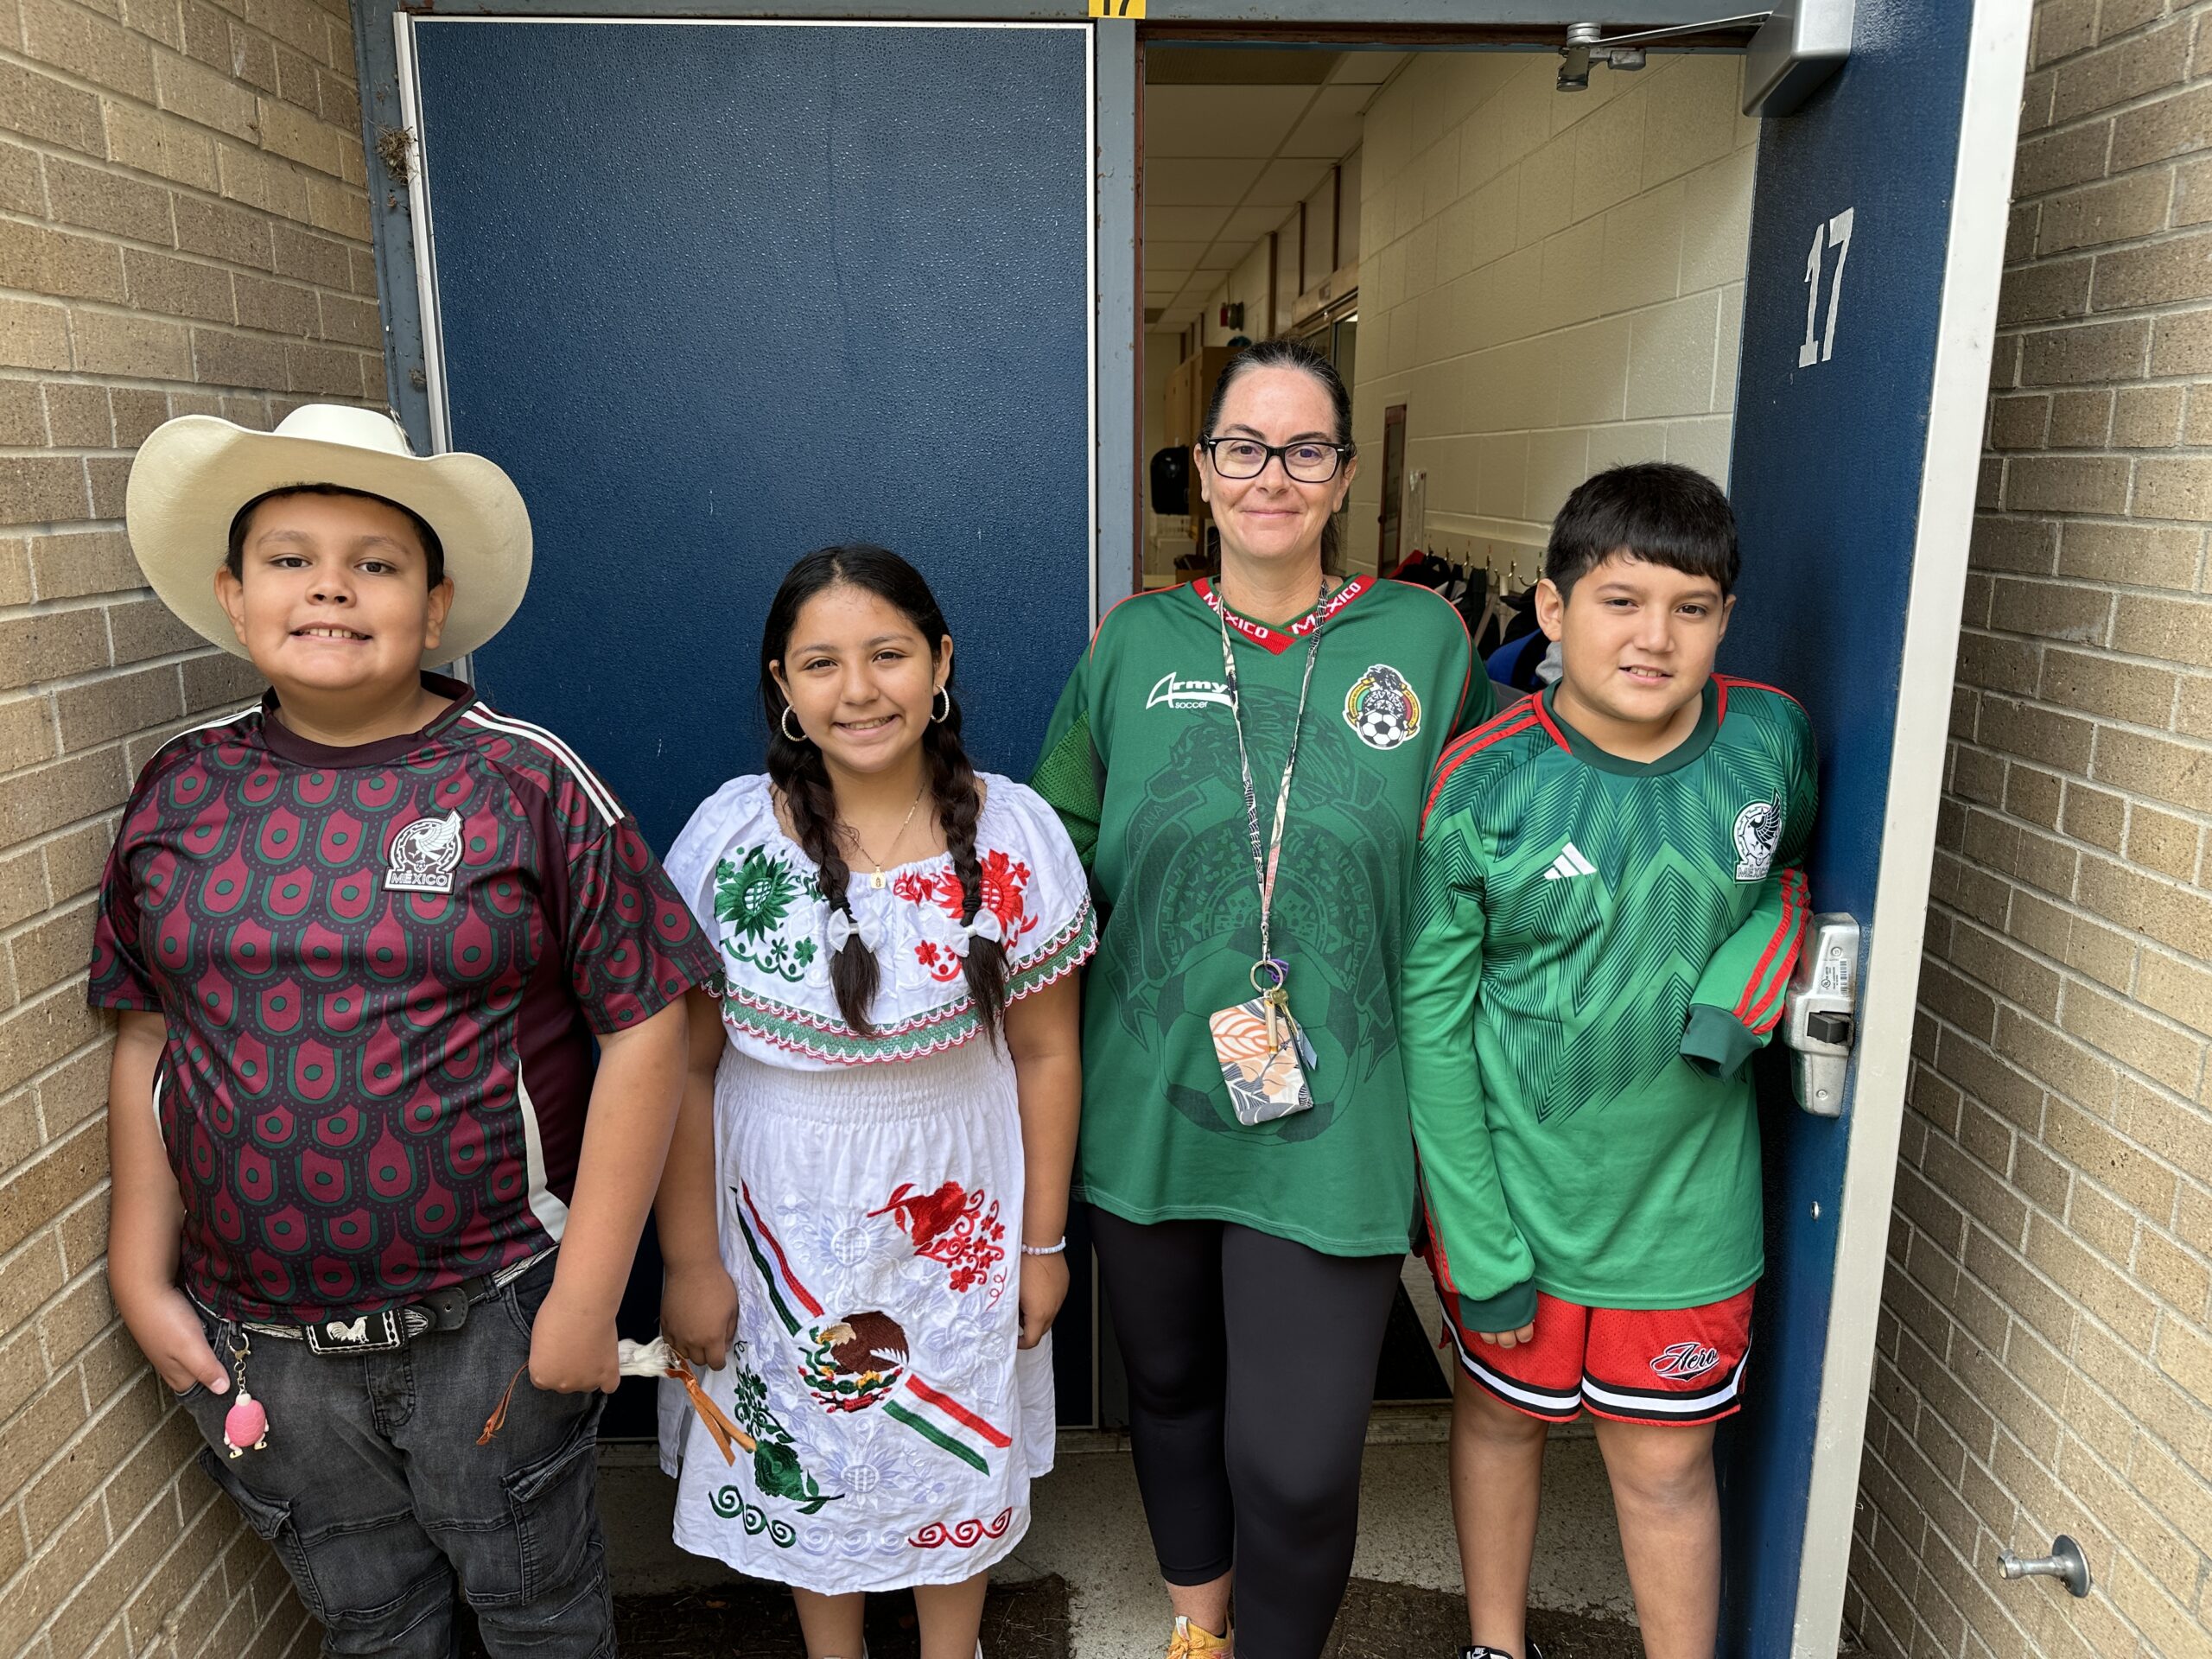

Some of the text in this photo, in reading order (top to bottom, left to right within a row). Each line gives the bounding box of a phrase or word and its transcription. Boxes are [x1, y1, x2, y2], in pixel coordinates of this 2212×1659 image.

[1799, 207, 1854, 368] 17
[1291, 582, 1362, 634] MXICO
[1146, 671, 1230, 709] Army
[391, 870, 448, 887] MÉXICO
[1649, 1341, 1719, 1374] Aero
